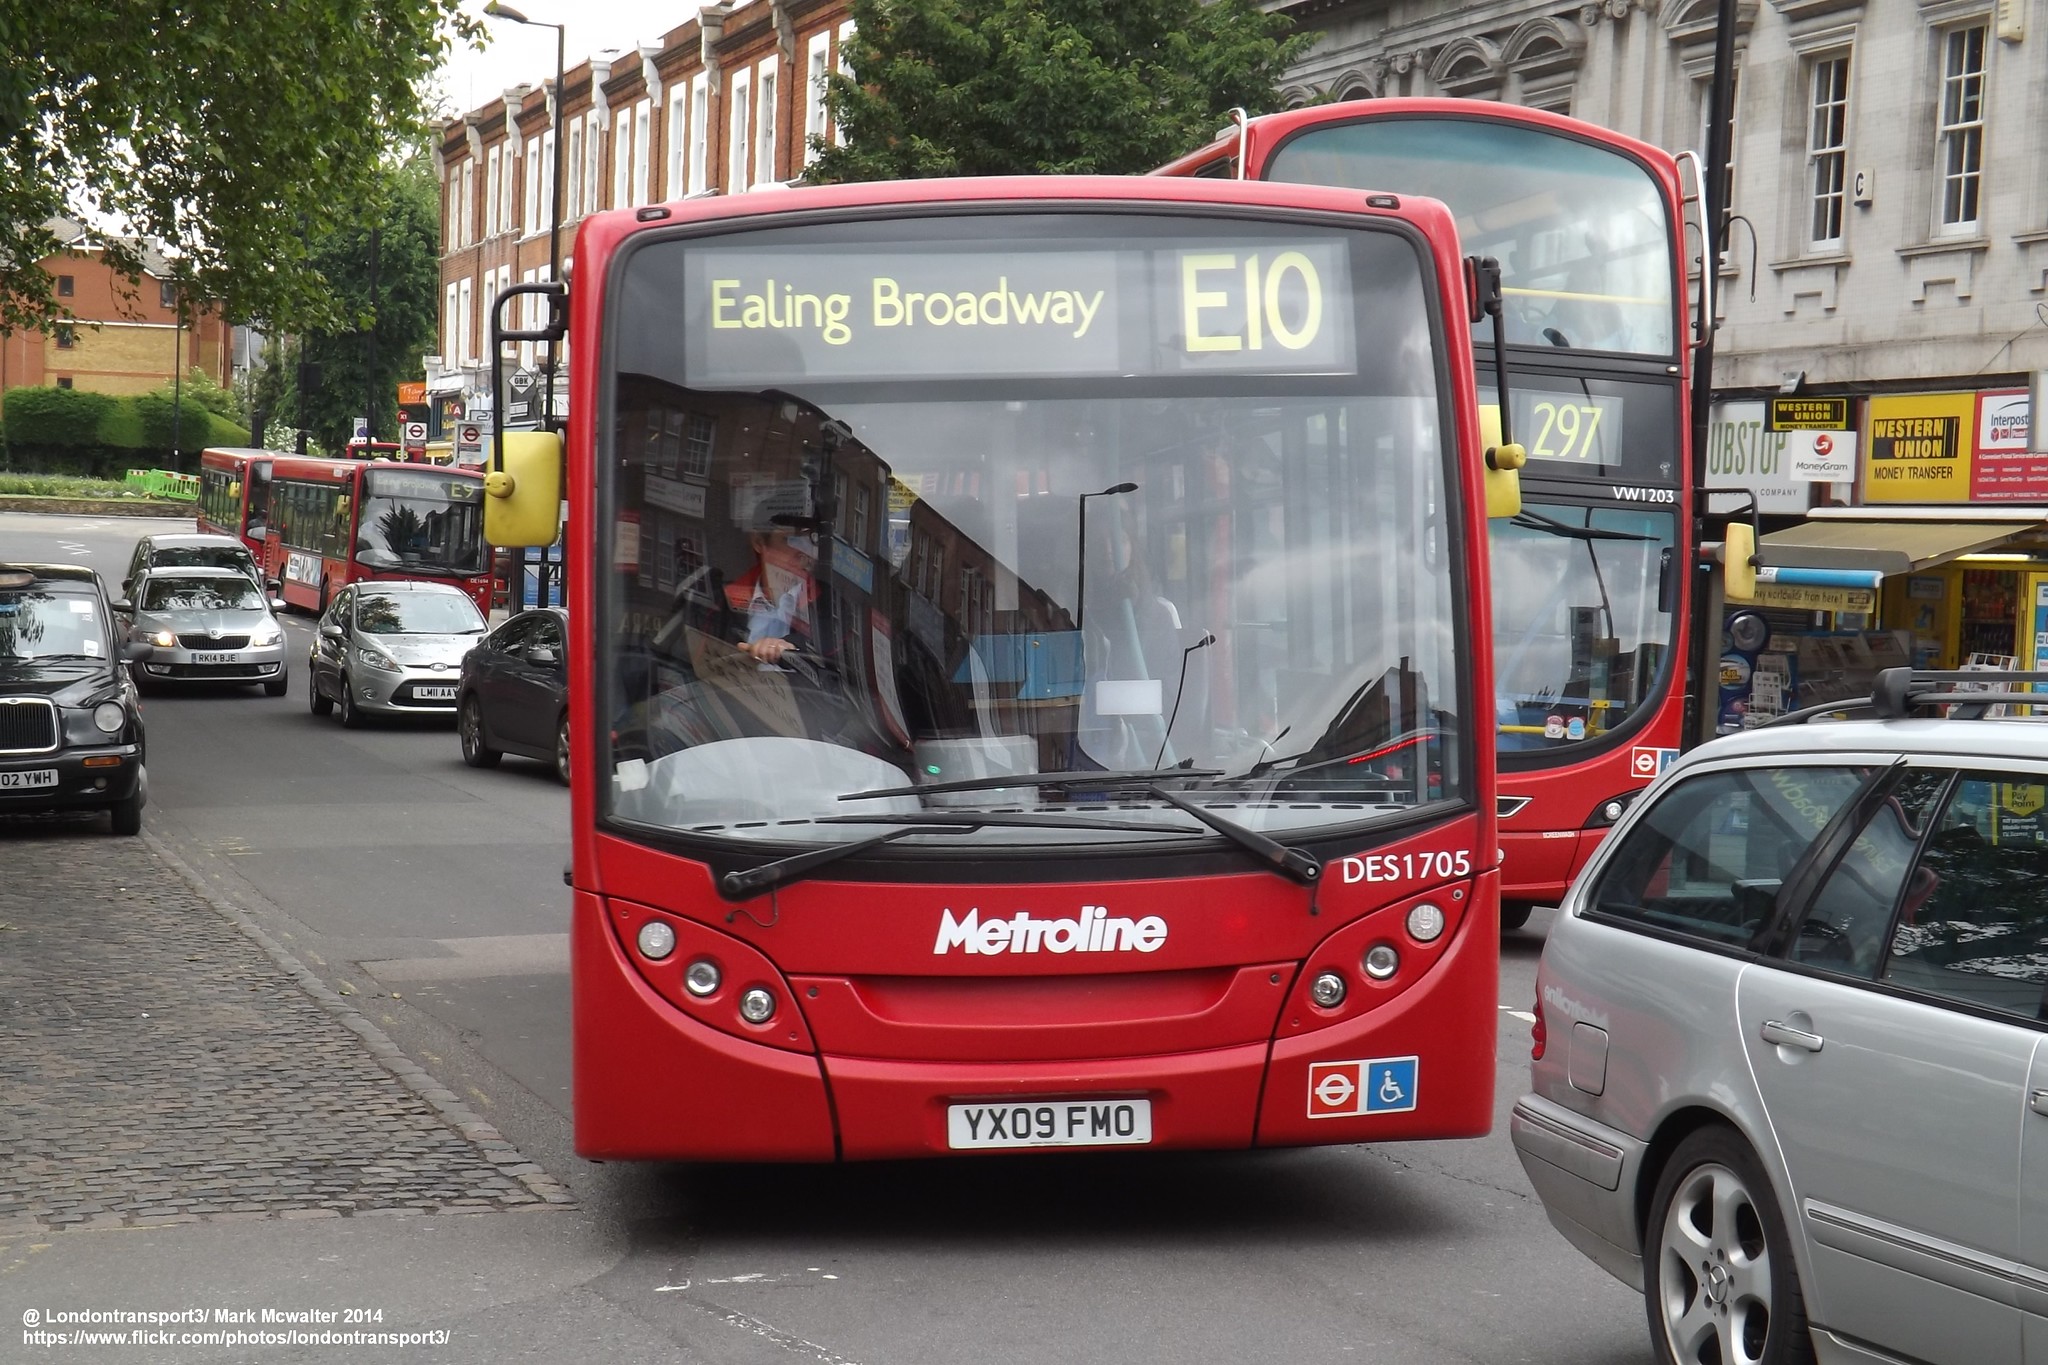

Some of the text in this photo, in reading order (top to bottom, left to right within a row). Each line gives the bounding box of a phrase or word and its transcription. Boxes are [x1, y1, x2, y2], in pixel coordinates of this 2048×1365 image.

[1181, 251, 1323, 352] E10
[712, 276, 1105, 345] Ealing Broadway
[514, 377, 529, 385] GBK
[1778, 403, 1831, 412] WESTERN
[1794, 411, 1831, 421] UNION
[1532, 402, 1603, 459] 297
[1874, 418, 1943, 438] WESTERN
[1710, 421, 1786, 475] UBSTOP
[1894, 439, 1943, 459] UNION
[1796, 462, 1848, 472] MoneyGram
[1874, 466, 1953, 479] MONEY TRANSFER
[451, 482, 475, 498] E9
[1613, 486, 1674, 504] VW1203
[1759, 488, 1799, 497] COMPANY
[1804, 592, 1820, 602] from
[198, 654, 236, 662] RK14 BJE
[420, 688, 438, 697] LM11
[1, 770, 52, 786] 02 YWH
[2012, 792, 2028, 801] Pay
[2012, 800, 2035, 808] Point
[1342, 850, 1471, 884] DES1705
[934, 906, 1168, 956] Metroline
[965, 1104, 1135, 1141] YX09 FMO
